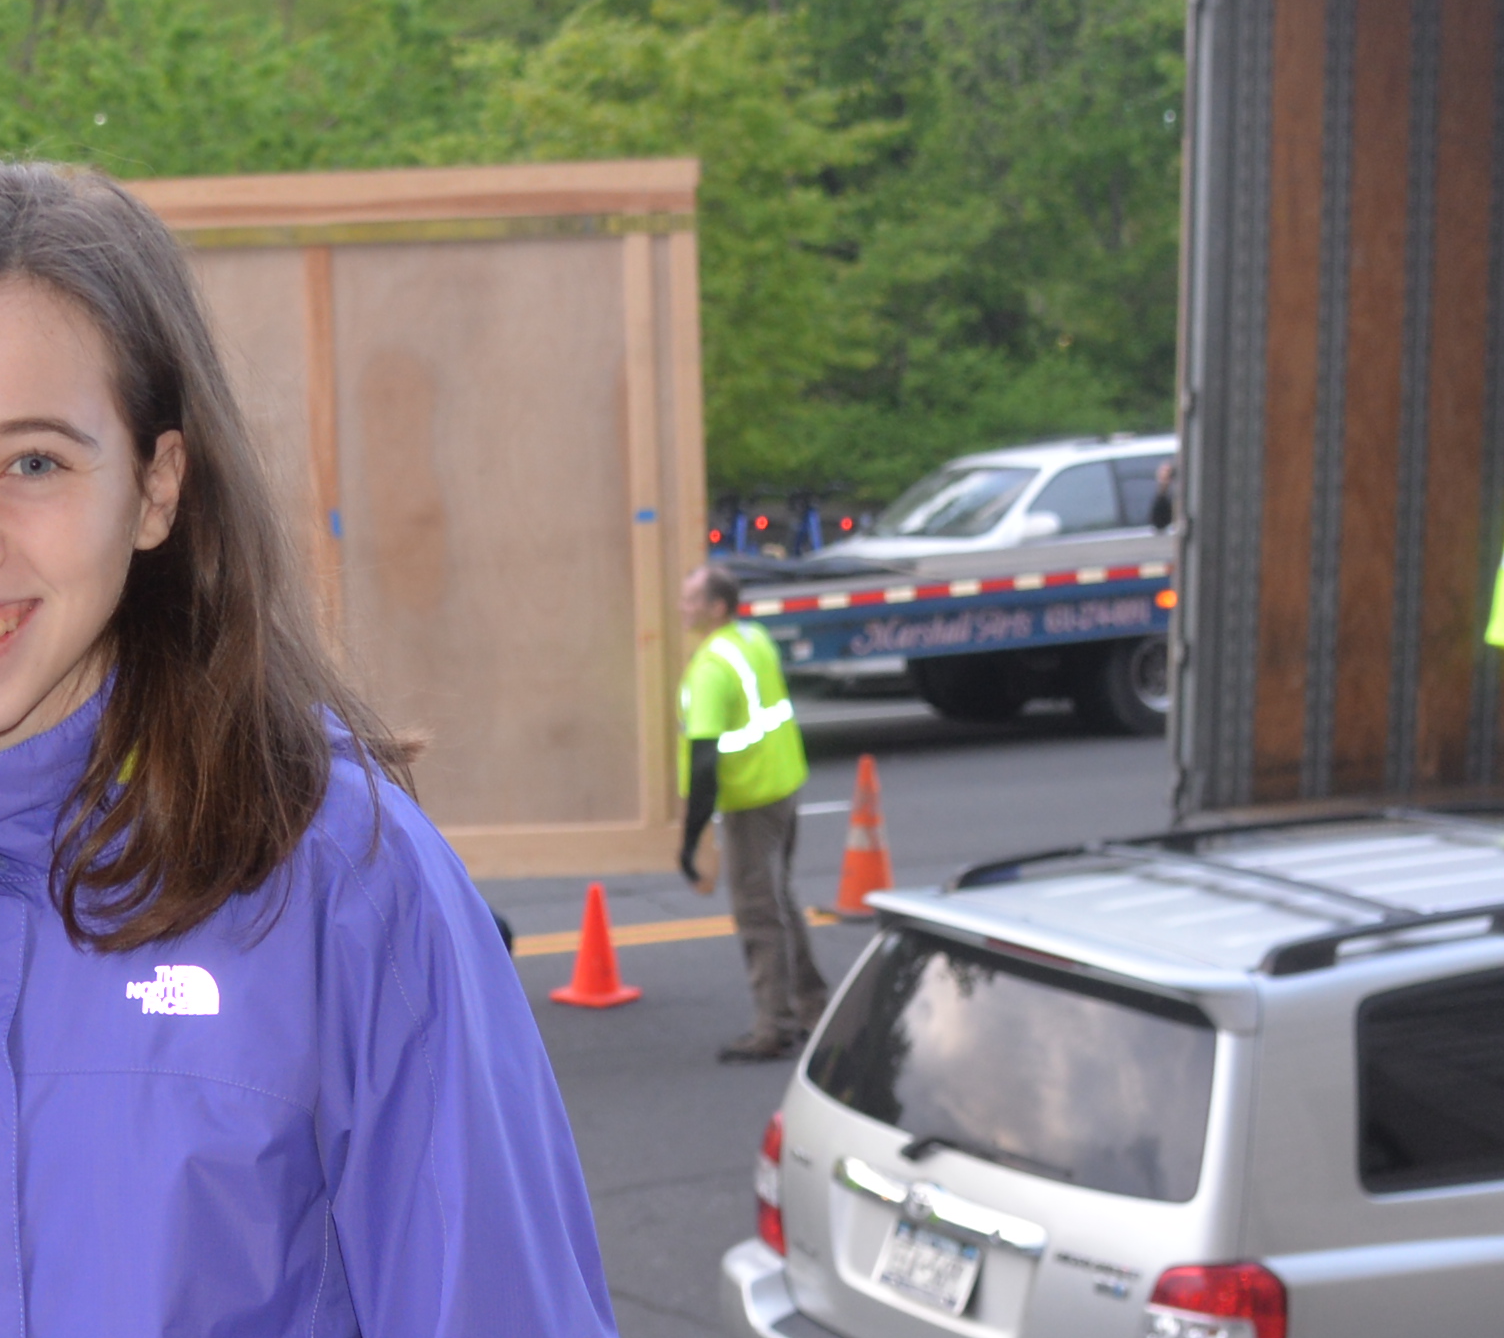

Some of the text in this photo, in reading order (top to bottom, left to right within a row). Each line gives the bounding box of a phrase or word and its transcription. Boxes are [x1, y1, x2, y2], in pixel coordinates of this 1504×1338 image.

[154, 965, 188, 982] THE
[126, 981, 188, 999] NORTH
[142, 997, 188, 1015] FACE
